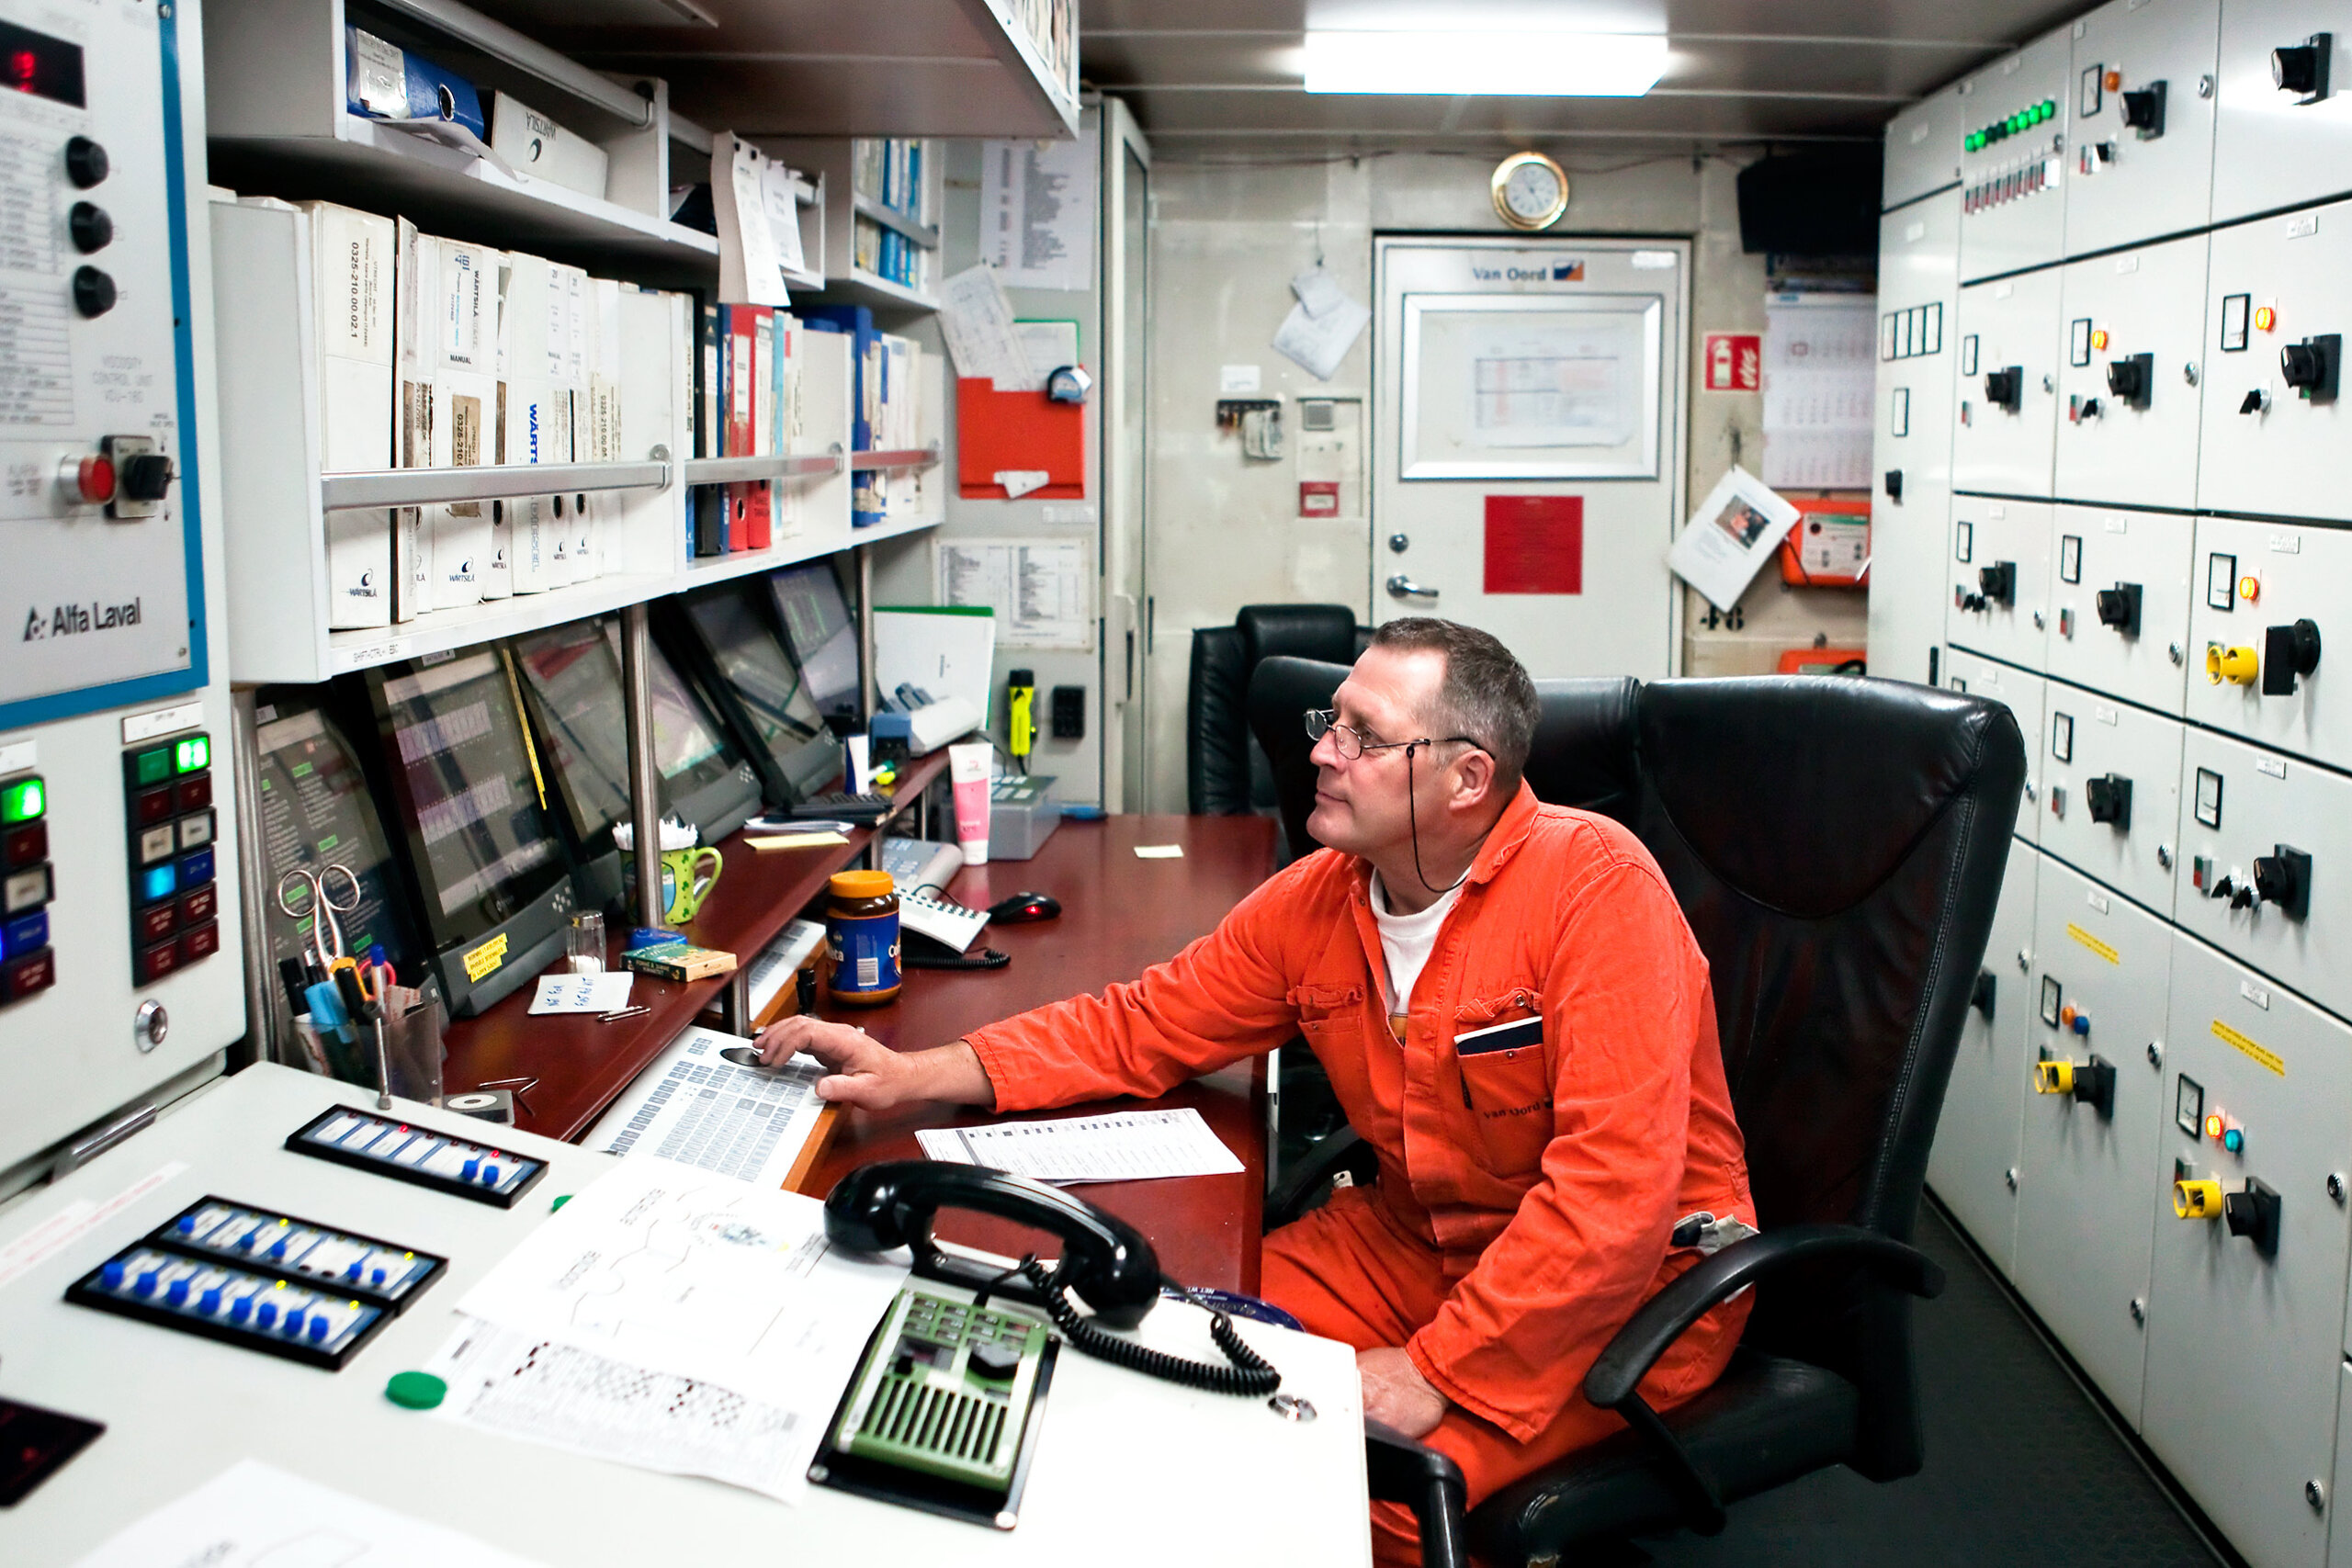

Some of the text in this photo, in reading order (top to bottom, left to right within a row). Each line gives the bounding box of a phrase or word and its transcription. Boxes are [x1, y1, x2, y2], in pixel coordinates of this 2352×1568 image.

[350, 242, 359, 339] 0325-210.00.02.1
[1473, 266, 1546, 280] Van Oord
[450, 354, 471, 365] MANUAL
[529, 403, 538, 464] WÄRTS
[52, 596, 141, 637] Alfa Laval
